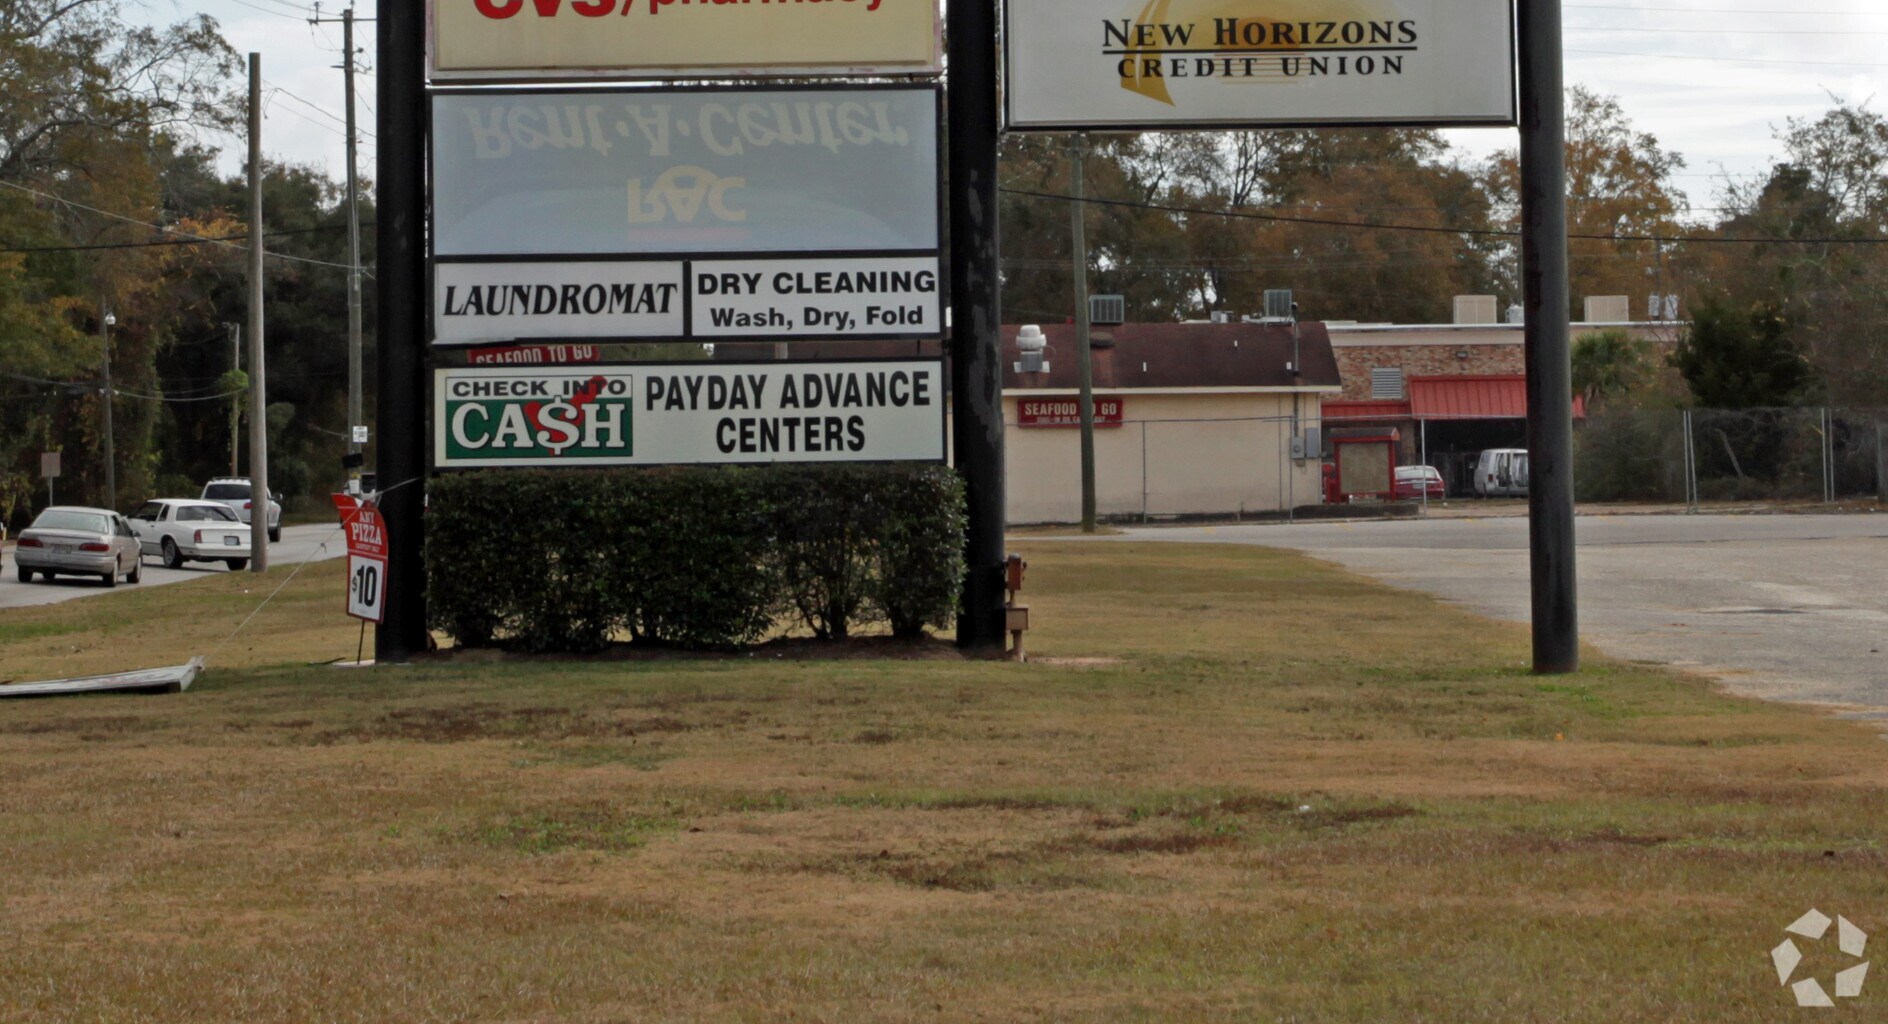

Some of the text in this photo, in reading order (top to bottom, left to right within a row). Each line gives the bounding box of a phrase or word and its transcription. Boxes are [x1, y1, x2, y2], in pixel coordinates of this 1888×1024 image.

[1117, 55, 1404, 78] CREDIT UNION
[698, 270, 936, 295] DRY CLEANING
[442, 283, 678, 317] LAUNDROMAT
[710, 305, 924, 331] Wash, Dry, Fold
[547, 345, 567, 363] TO
[573, 344, 593, 360] GO
[452, 378, 627, 397] CHECK INTO
[646, 370, 931, 411] PAYDAY ADVANCE
[1025, 403, 1076, 415] SEAFOOD
[1102, 403, 1116, 415] GO
[716, 415, 866, 454] CENTERS
[351, 523, 382, 545] PIZZA
[352, 564, 377, 607] $10
